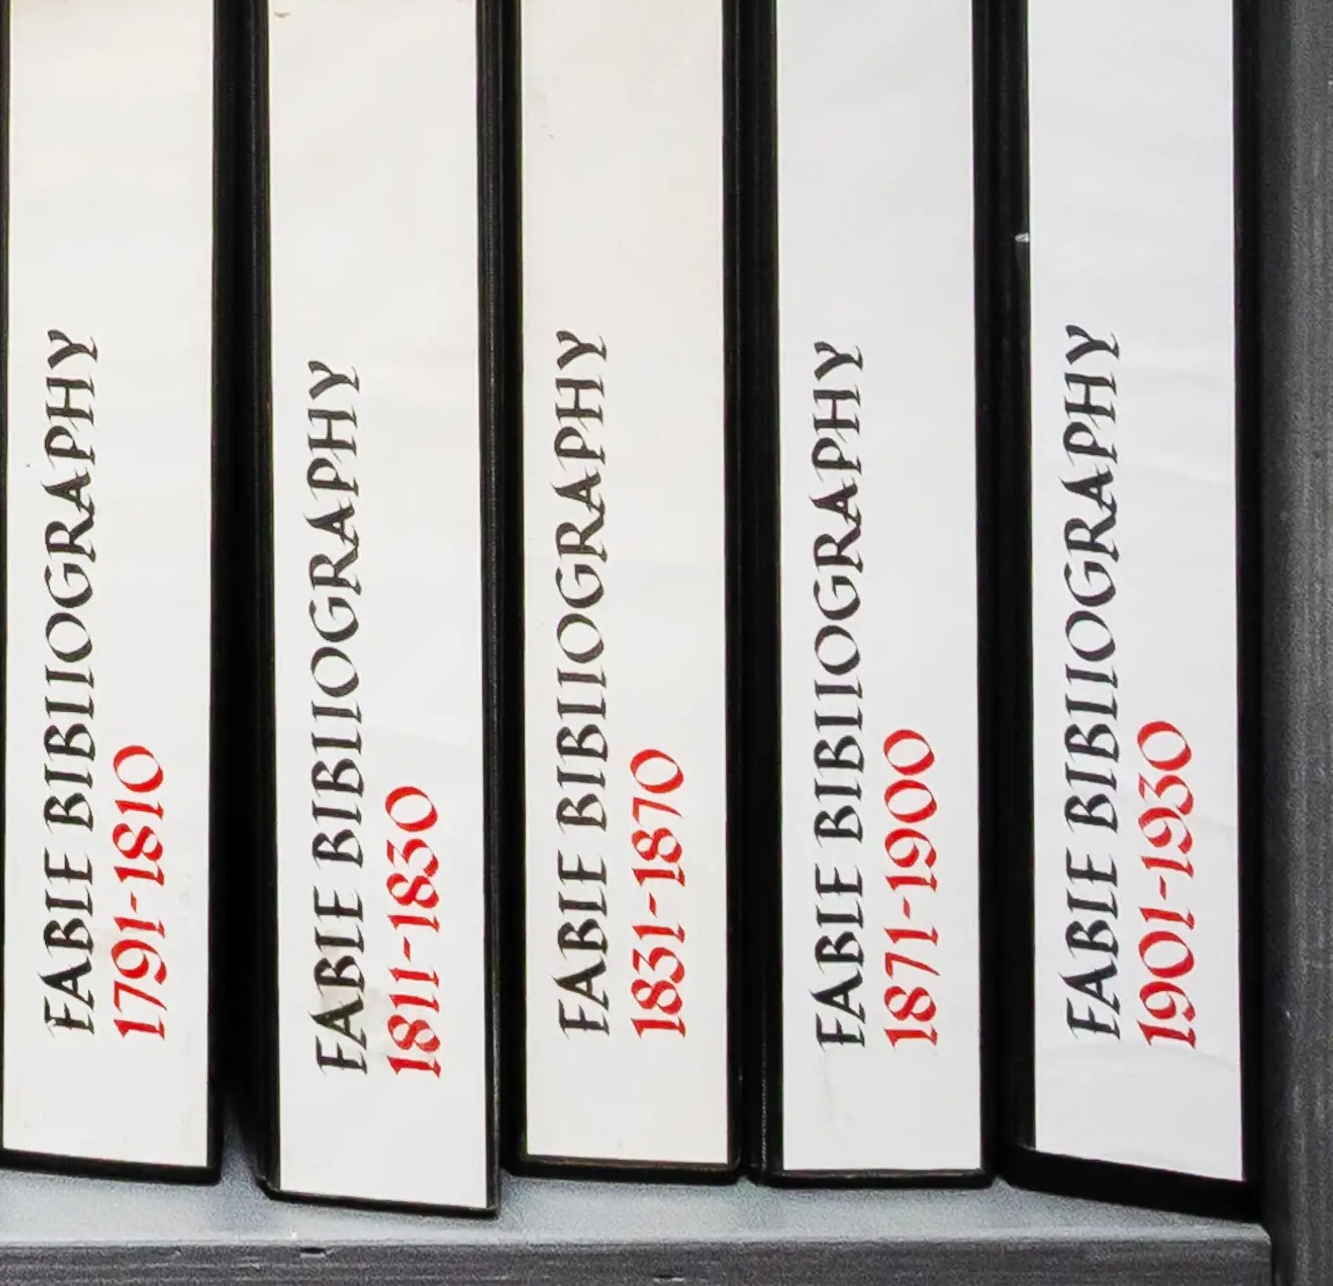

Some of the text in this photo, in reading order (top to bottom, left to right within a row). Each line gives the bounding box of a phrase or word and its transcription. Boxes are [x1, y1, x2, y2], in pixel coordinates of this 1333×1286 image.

[40, 330, 97, 1034] FABLE BIBLIOGRAPHY
[111, 745, 167, 1039] 1791-1810
[553, 331, 609, 1035] FABLE BIBLIOGRAPHY
[630, 749, 686, 1037] 1831-1870
[1061, 325, 1120, 1039] FABLE BIBLIOGRAPHY
[1137, 721, 1196, 1048] 1901-1930
